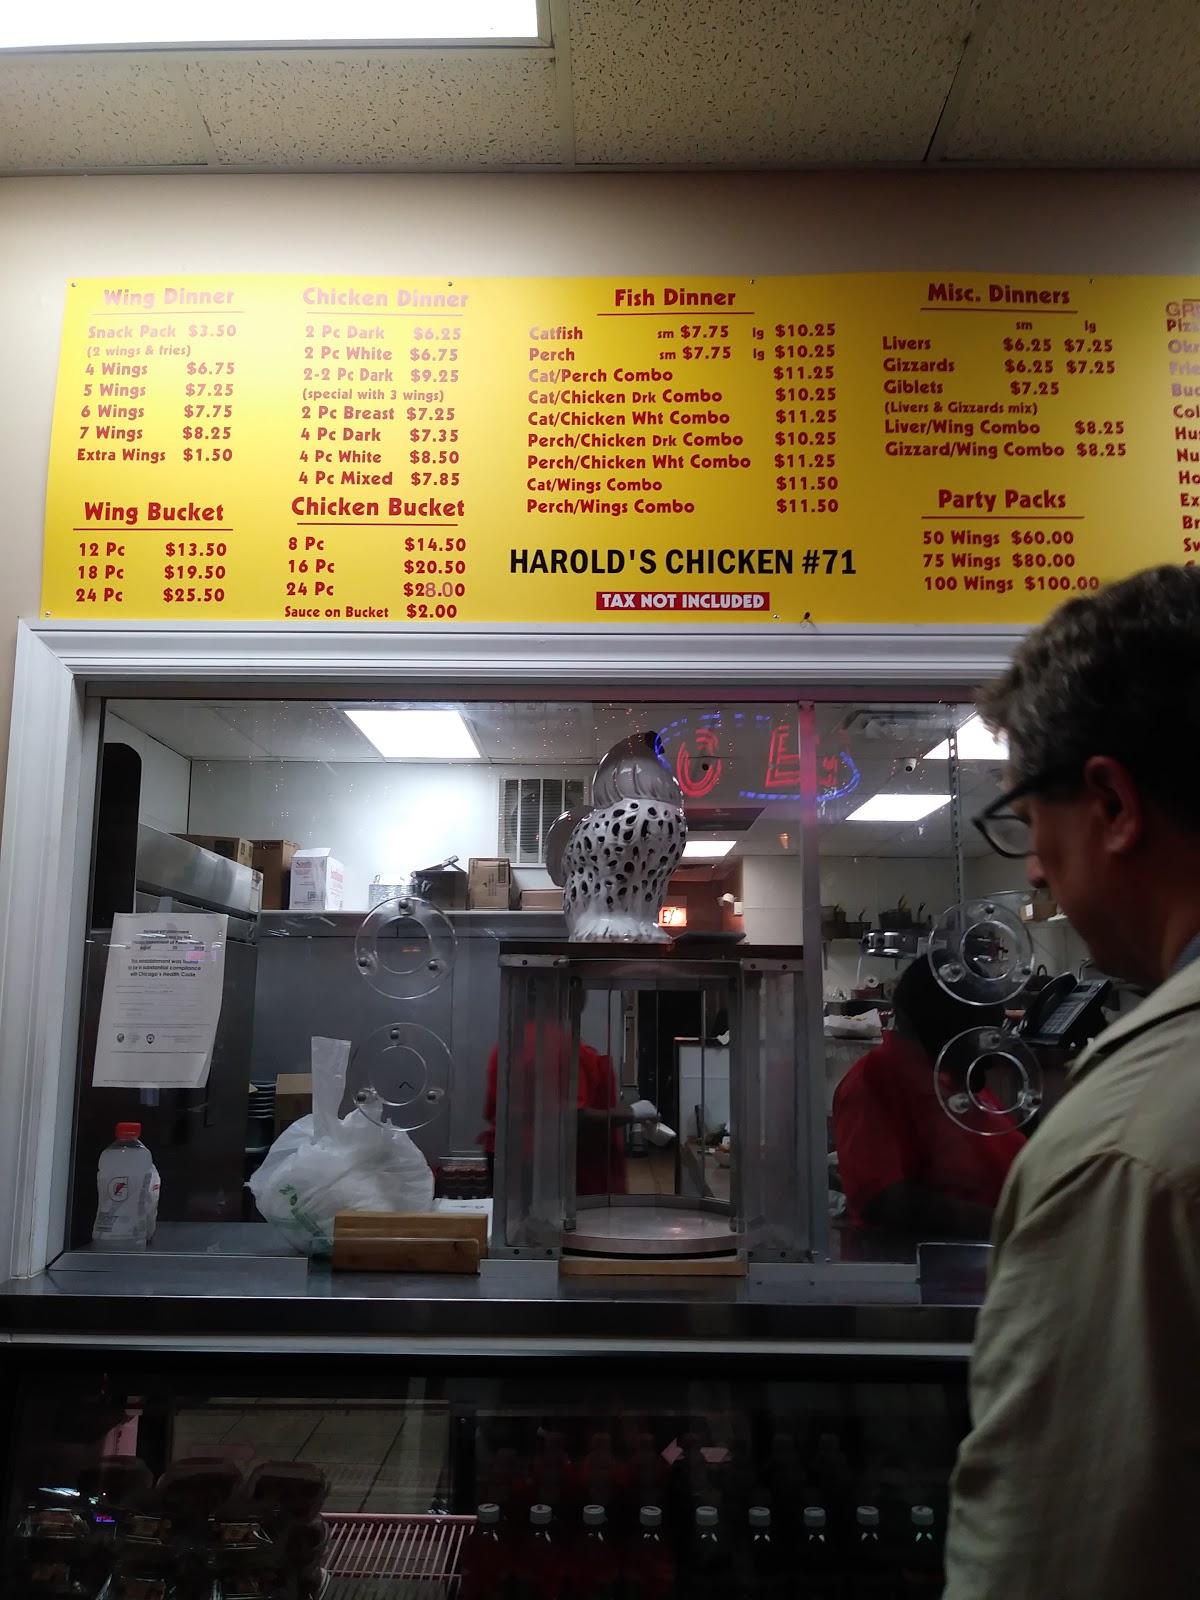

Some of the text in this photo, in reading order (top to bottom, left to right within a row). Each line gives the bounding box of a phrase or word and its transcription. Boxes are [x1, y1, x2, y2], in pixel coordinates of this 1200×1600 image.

[104, 287, 234, 309] Wing Dinner
[302, 287, 469, 308] Chicken Dinner
[615, 288, 736, 307] Fish Dinner
[928, 283, 1070, 304] Misc. Dinners
[88, 324, 237, 339] Snack Pack $3.50
[529, 323, 835, 340] Catfish sm $7.75 lg $10.25
[1016, 320, 1096, 334] sm lg
[87, 344, 191, 359] (2 wings & fries)
[530, 344, 835, 361] Perch sm $7.75 lg $10.25
[882, 336, 1113, 353] Livers $6.25 $7.25
[304, 346, 458, 362] 2 Pc White $6.75
[85, 361, 235, 378] 4 Wings $6.75
[529, 365, 834, 382] Cat/Perch Combo $11.25
[883, 357, 1115, 375] Gizzards $6.25 $7.25
[303, 367, 459, 383] 2-2 Pc Dark $9.25
[83, 382, 234, 400] 5 Wings $7.25
[302, 388, 444, 403] (special with 3 wings)
[528, 387, 836, 405] Cat/Chicken Drk Combo $10.25
[883, 379, 1059, 396] Giblets $7.25
[301, 405, 455, 421] 2 Pc Breast $7.25
[885, 401, 1038, 416] (Livers & Gizzards mix)
[528, 409, 837, 427] Cat/Chicken Wht Combo $11.25
[80, 425, 231, 442] 7 Wings $8.25
[301, 427, 459, 443] 4 Pc Dark $7.35
[885, 419, 1124, 437] Liver/Wing Combo $8.25
[528, 431, 836, 449] Perch/Chicken Drk Combo $10.25
[77, 447, 233, 464] Extra Wings $1.50
[885, 441, 1126, 460] Gizzard/Wing Combo $8.25
[528, 453, 835, 471] Perch/Chicken Wht Combo $11.25
[298, 470, 460, 486] 4 Pc Mixed $7.85
[527, 475, 838, 494] Cat/Wings Combo $11.50
[291, 496, 465, 517] Chicken Bucket
[527, 498, 839, 517] Perch/Wings Combo $11.50
[938, 489, 1066, 513] Party Packs
[84, 502, 224, 525] Wing Bucket
[288, 536, 466, 552] 8 Pc $14.50
[923, 530, 1074, 548] 50 Wings $60.00
[79, 542, 227, 557] 12 Pc $13.50
[288, 559, 466, 575] 16 Pc $20.50
[510, 549, 856, 574] HAROLD'S CHICKEN #71
[923, 552, 1075, 571] 75 Wings $80.00
[78, 564, 226, 580] 18 Pc $19.50
[286, 581, 465, 598] 24 Pc $28.00
[924, 575, 1099, 594] 100 Wings $100.00
[76, 587, 225, 603] 24 Pc $25.50
[602, 594, 764, 608] TAX NOT INCLUDED
[285, 603, 457, 619] Sauce on Bucket $2.00
